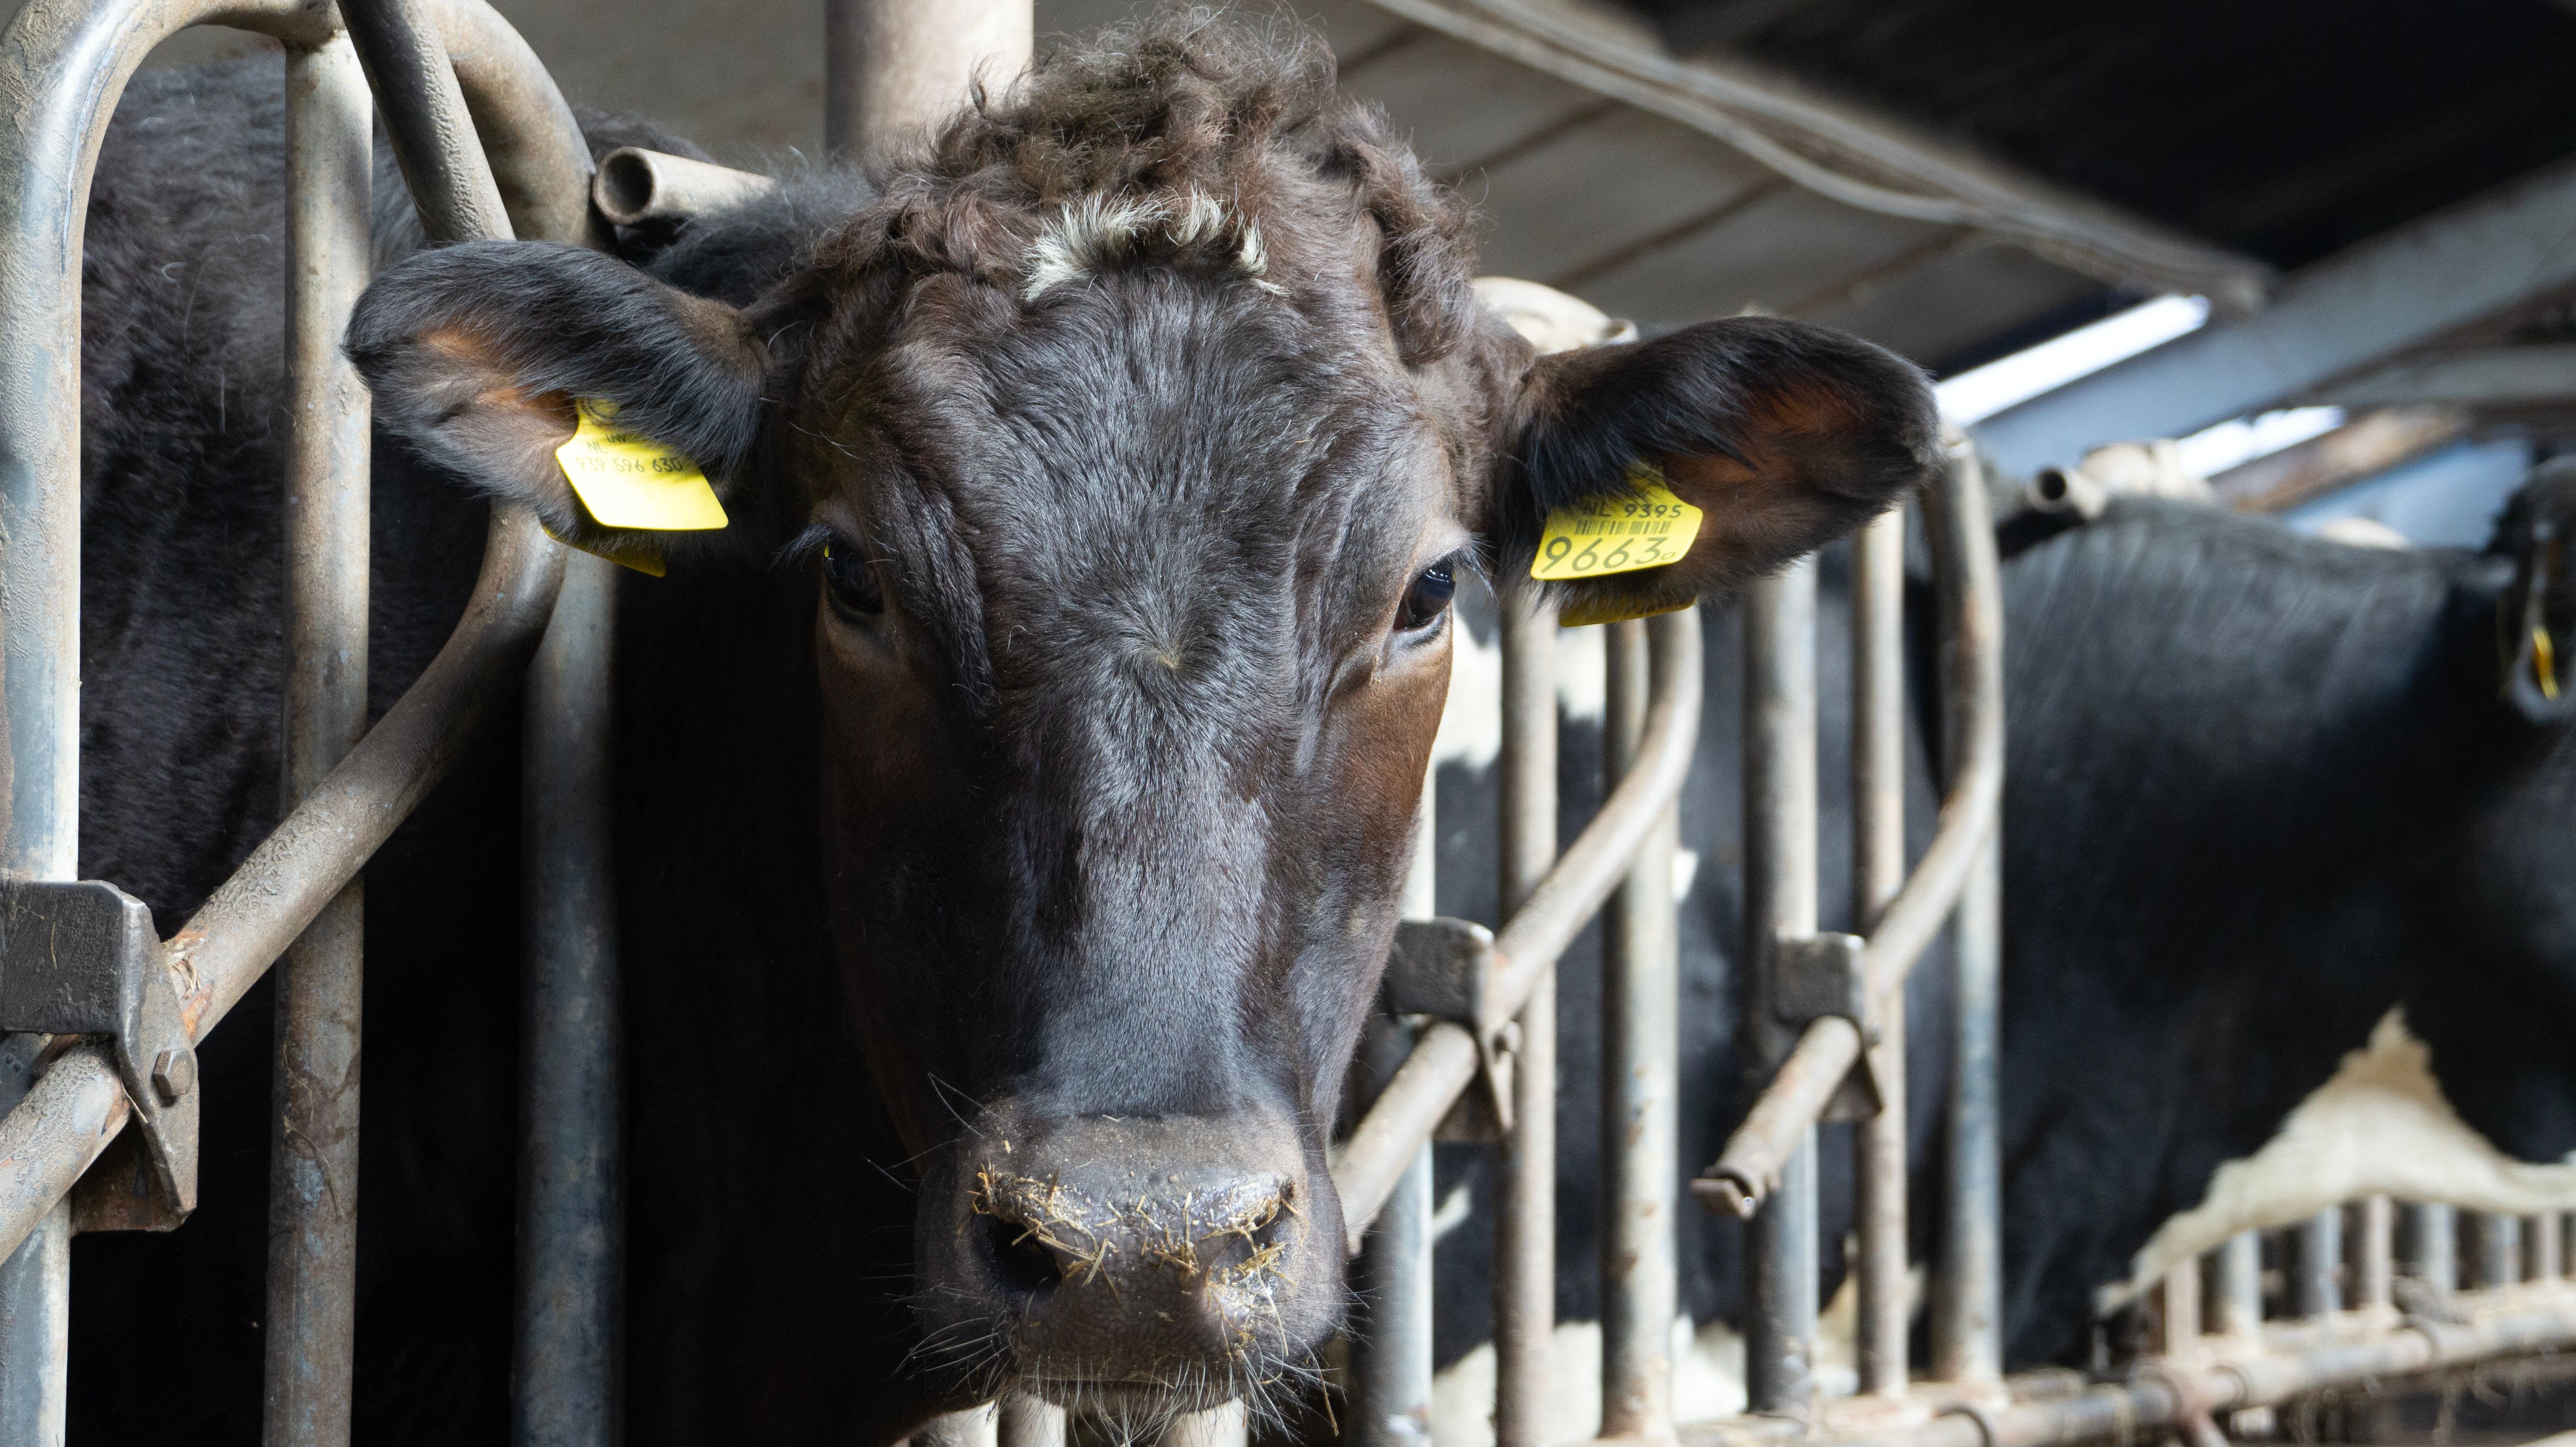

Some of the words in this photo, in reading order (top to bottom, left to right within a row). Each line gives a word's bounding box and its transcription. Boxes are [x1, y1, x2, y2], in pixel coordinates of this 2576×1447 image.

[586, 441, 608, 453] NL
[575, 456, 605, 471] 939
[612, 458, 645, 472] 596
[652, 457, 683, 472] 630
[1624, 503, 1683, 518] 9395
